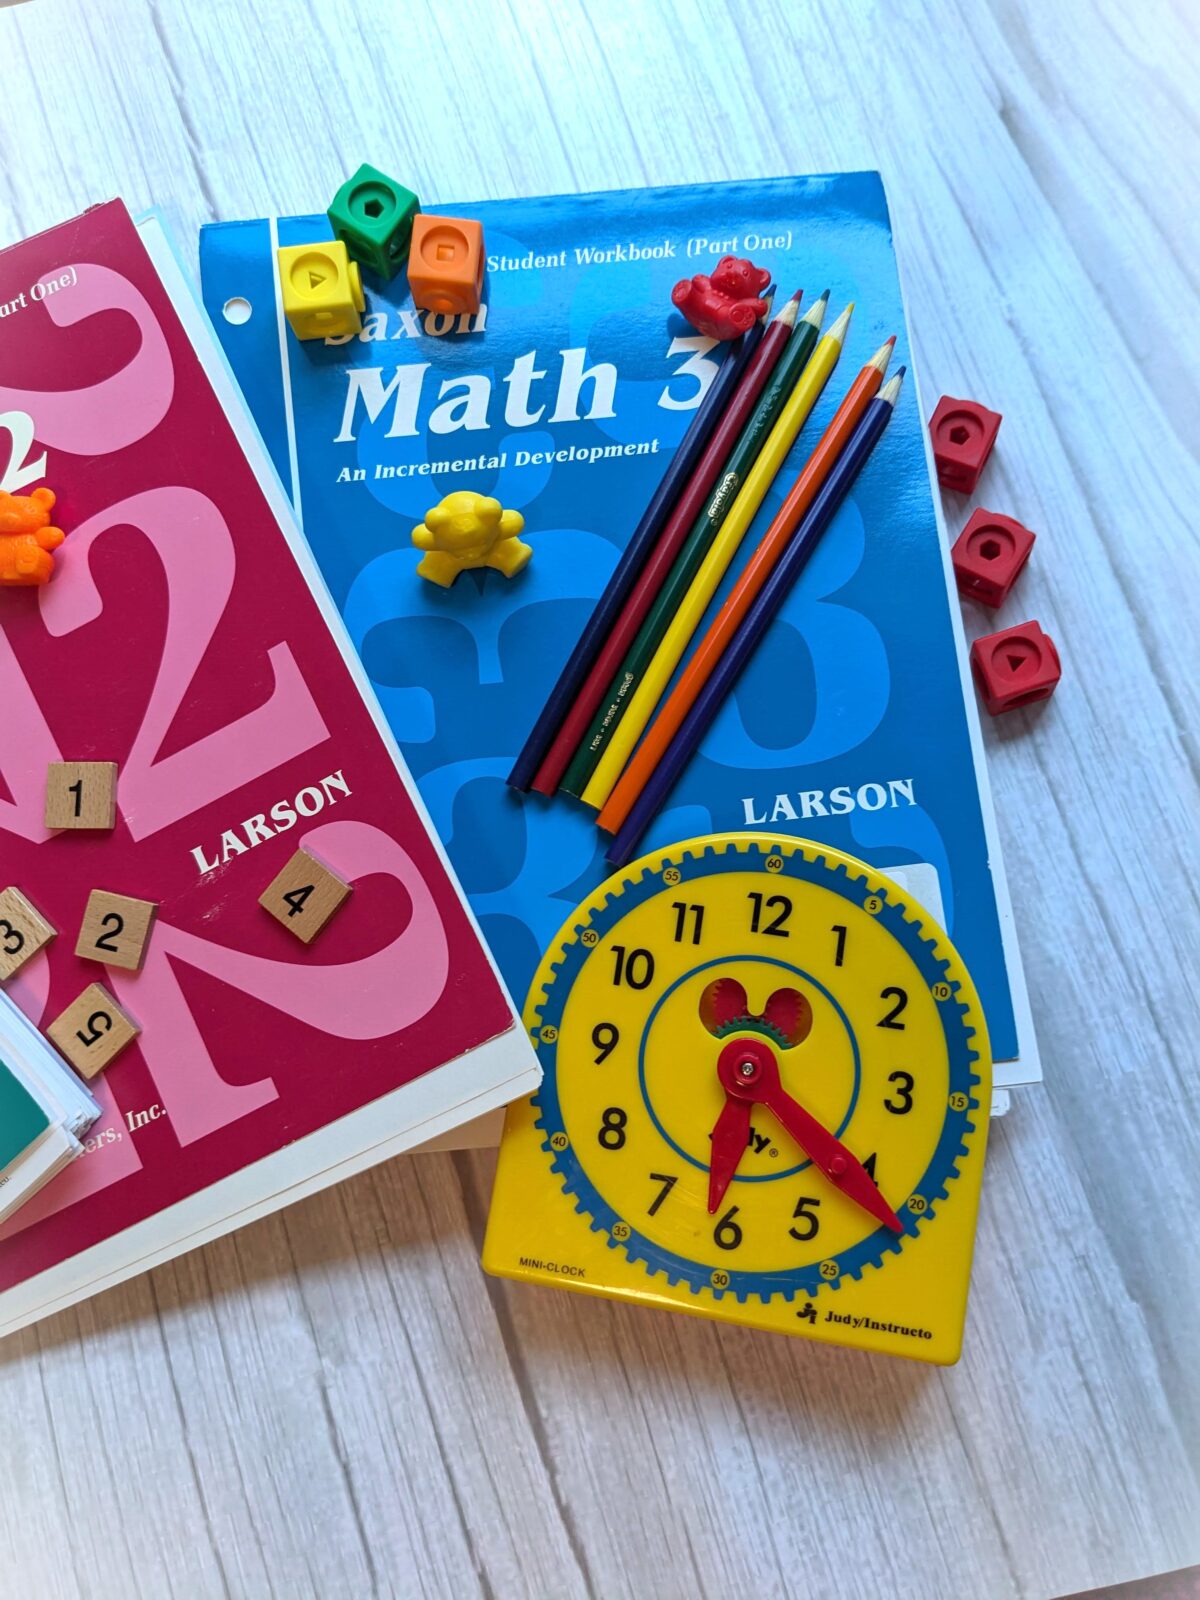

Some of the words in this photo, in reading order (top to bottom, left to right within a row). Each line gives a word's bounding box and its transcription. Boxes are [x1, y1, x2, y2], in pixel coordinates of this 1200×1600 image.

[486, 249, 567, 272] Student
[574, 239, 676, 265] Workbook
[686, 231, 738, 258] (Part
[743, 230, 793, 254] One)
[30, 266, 78, 302] One)
[324, 303, 487, 346] axon
[333, 347, 617, 443] Math
[657, 336, 721, 411] 3
[336, 466, 366, 483] An
[374, 451, 507, 480] Incremental
[514, 438, 660, 468] Development
[68, 779, 83, 817] 1
[741, 778, 917, 825] LARSON
[190, 769, 353, 875] LARSON
[664, 870, 680, 882] 55
[767, 858, 782, 870] 60
[282, 884, 315, 918] 4
[747, 891, 793, 937] 12
[869, 899, 877, 911] 5
[0, 919, 25, 955] 3
[95, 912, 125, 953] 2
[582, 932, 597, 944] 50
[671, 901, 705, 945] 11
[831, 924, 848, 967] 1
[610, 944, 655, 990] 10
[876, 986, 909, 1031] 2
[934, 985, 949, 998] 10
[75, 1010, 113, 1047] 5
[542, 1028, 556, 1040] 45
[591, 1022, 620, 1065] 9
[883, 1070, 915, 1115] 3
[950, 1095, 965, 1108] 15
[125, 1103, 167, 1132] Inc.
[597, 1107, 628, 1150] 8
[552, 1135, 567, 1148] 40
[647, 1172, 679, 1217] 7
[909, 1198, 926, 1211] 20
[613, 1225, 628, 1238] 35
[713, 1205, 742, 1250] 6
[788, 1196, 820, 1241] 5
[518, 1256, 587, 1279] MINI-CLOCK
[712, 1273, 728, 1286] 30
[822, 1263, 838, 1277] 25
[824, 1310, 933, 1340] Judy/Instructo
